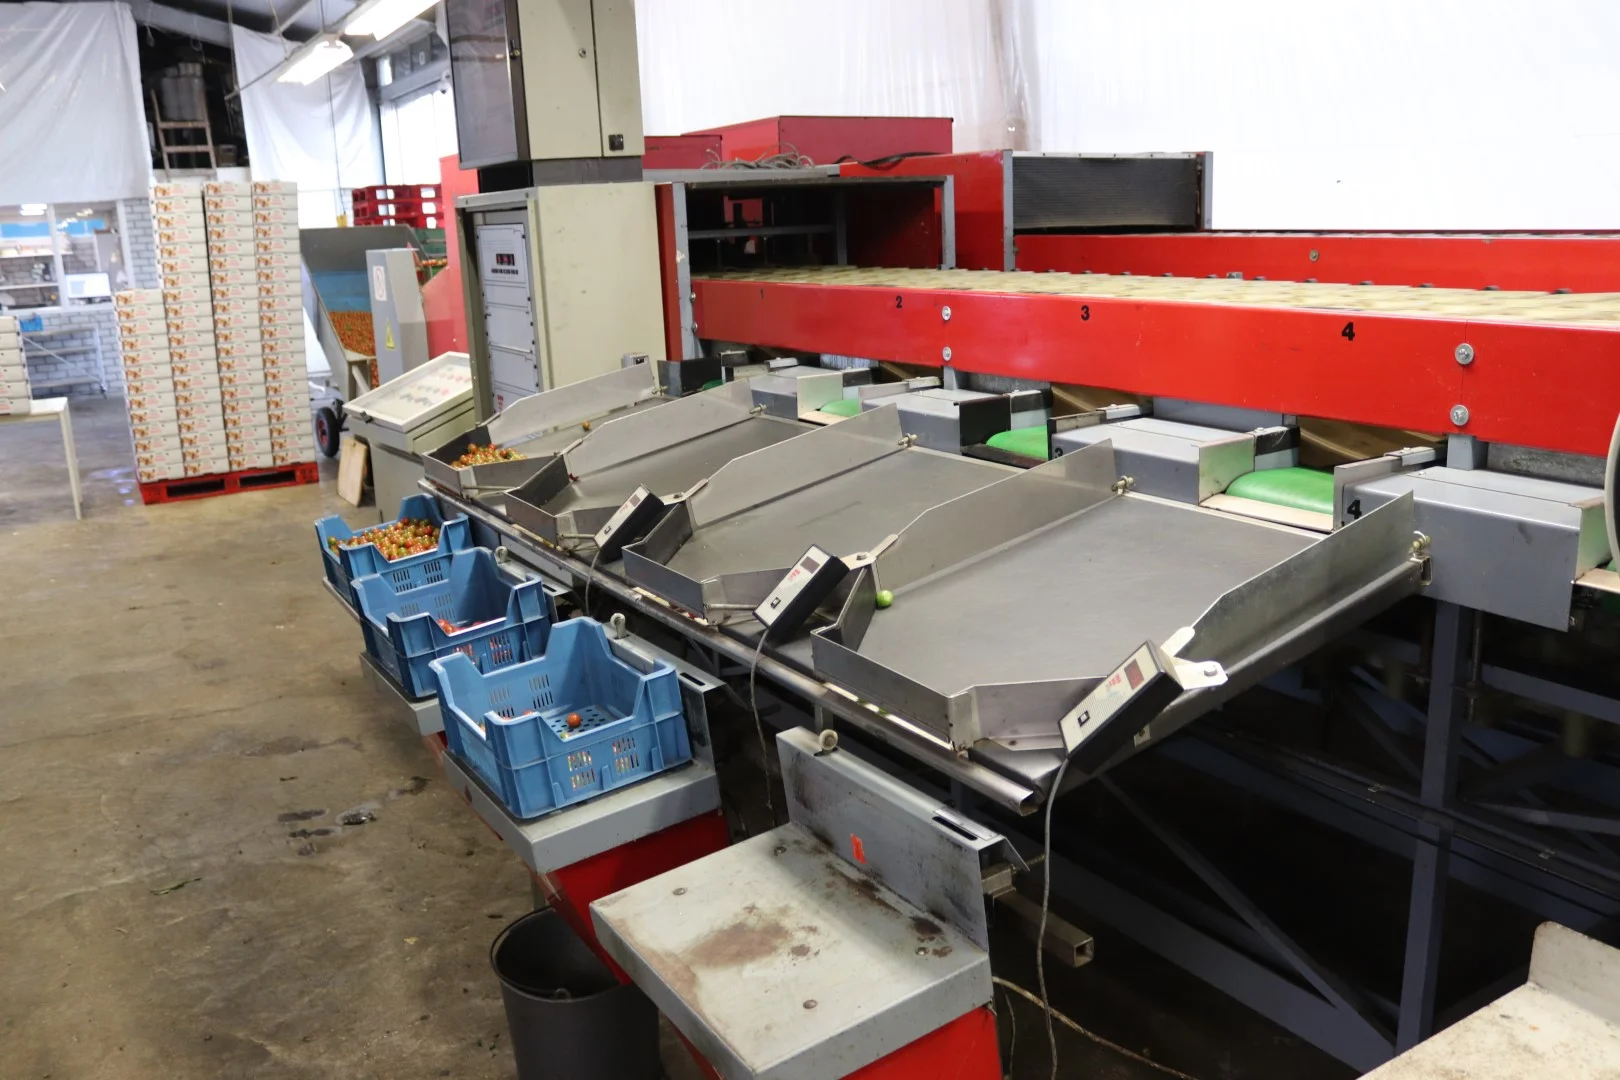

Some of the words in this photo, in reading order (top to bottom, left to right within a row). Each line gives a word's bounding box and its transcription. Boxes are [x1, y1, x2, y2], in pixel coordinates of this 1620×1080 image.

[896, 296, 902, 308] 2
[1081, 305, 1090, 321] 3
[1342, 322, 1355, 341] 4
[1347, 500, 1362, 519] 4
